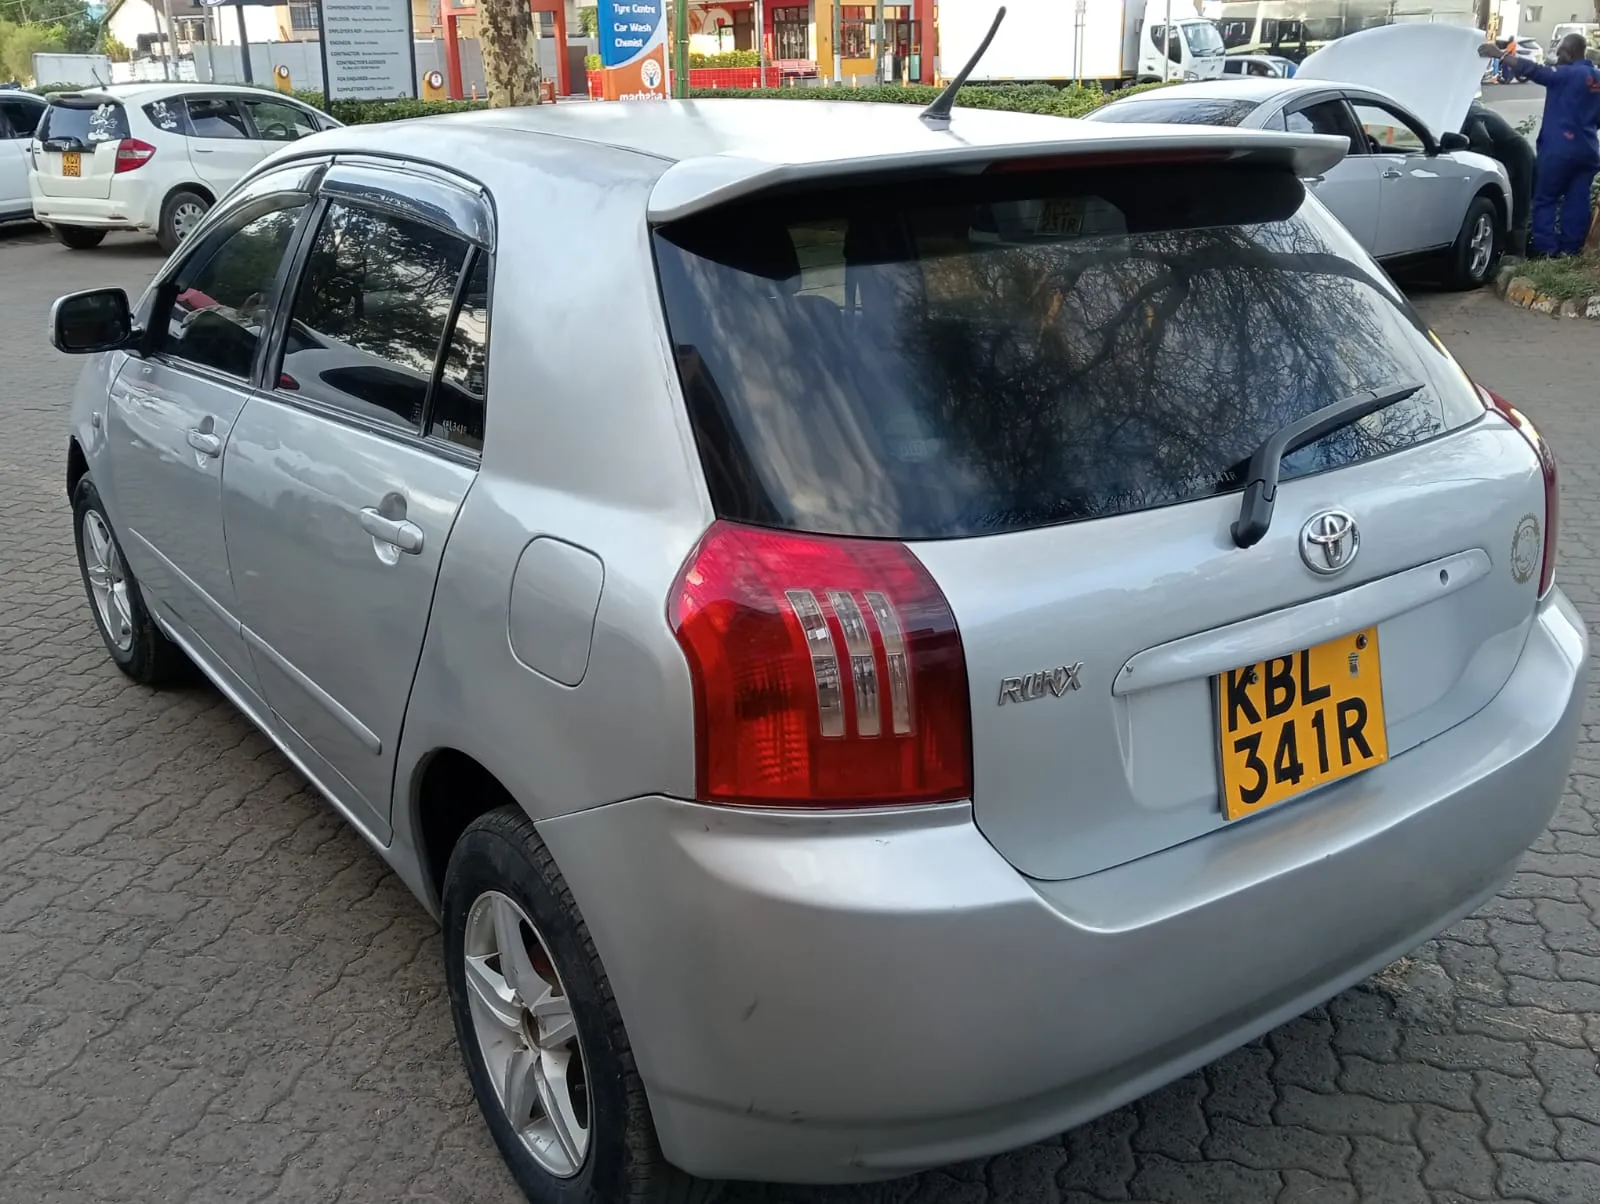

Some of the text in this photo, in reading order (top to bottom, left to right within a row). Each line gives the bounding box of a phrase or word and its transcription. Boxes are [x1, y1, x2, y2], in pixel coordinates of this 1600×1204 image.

[613, 4, 656, 15] Tyre Centre
[614, 23, 652, 32] Car Wash
[615, 38, 643, 47] Chemist
[998, 661, 1085, 706] RUNX
[1227, 650, 1332, 732] KBL
[1233, 697, 1374, 804] 341R
